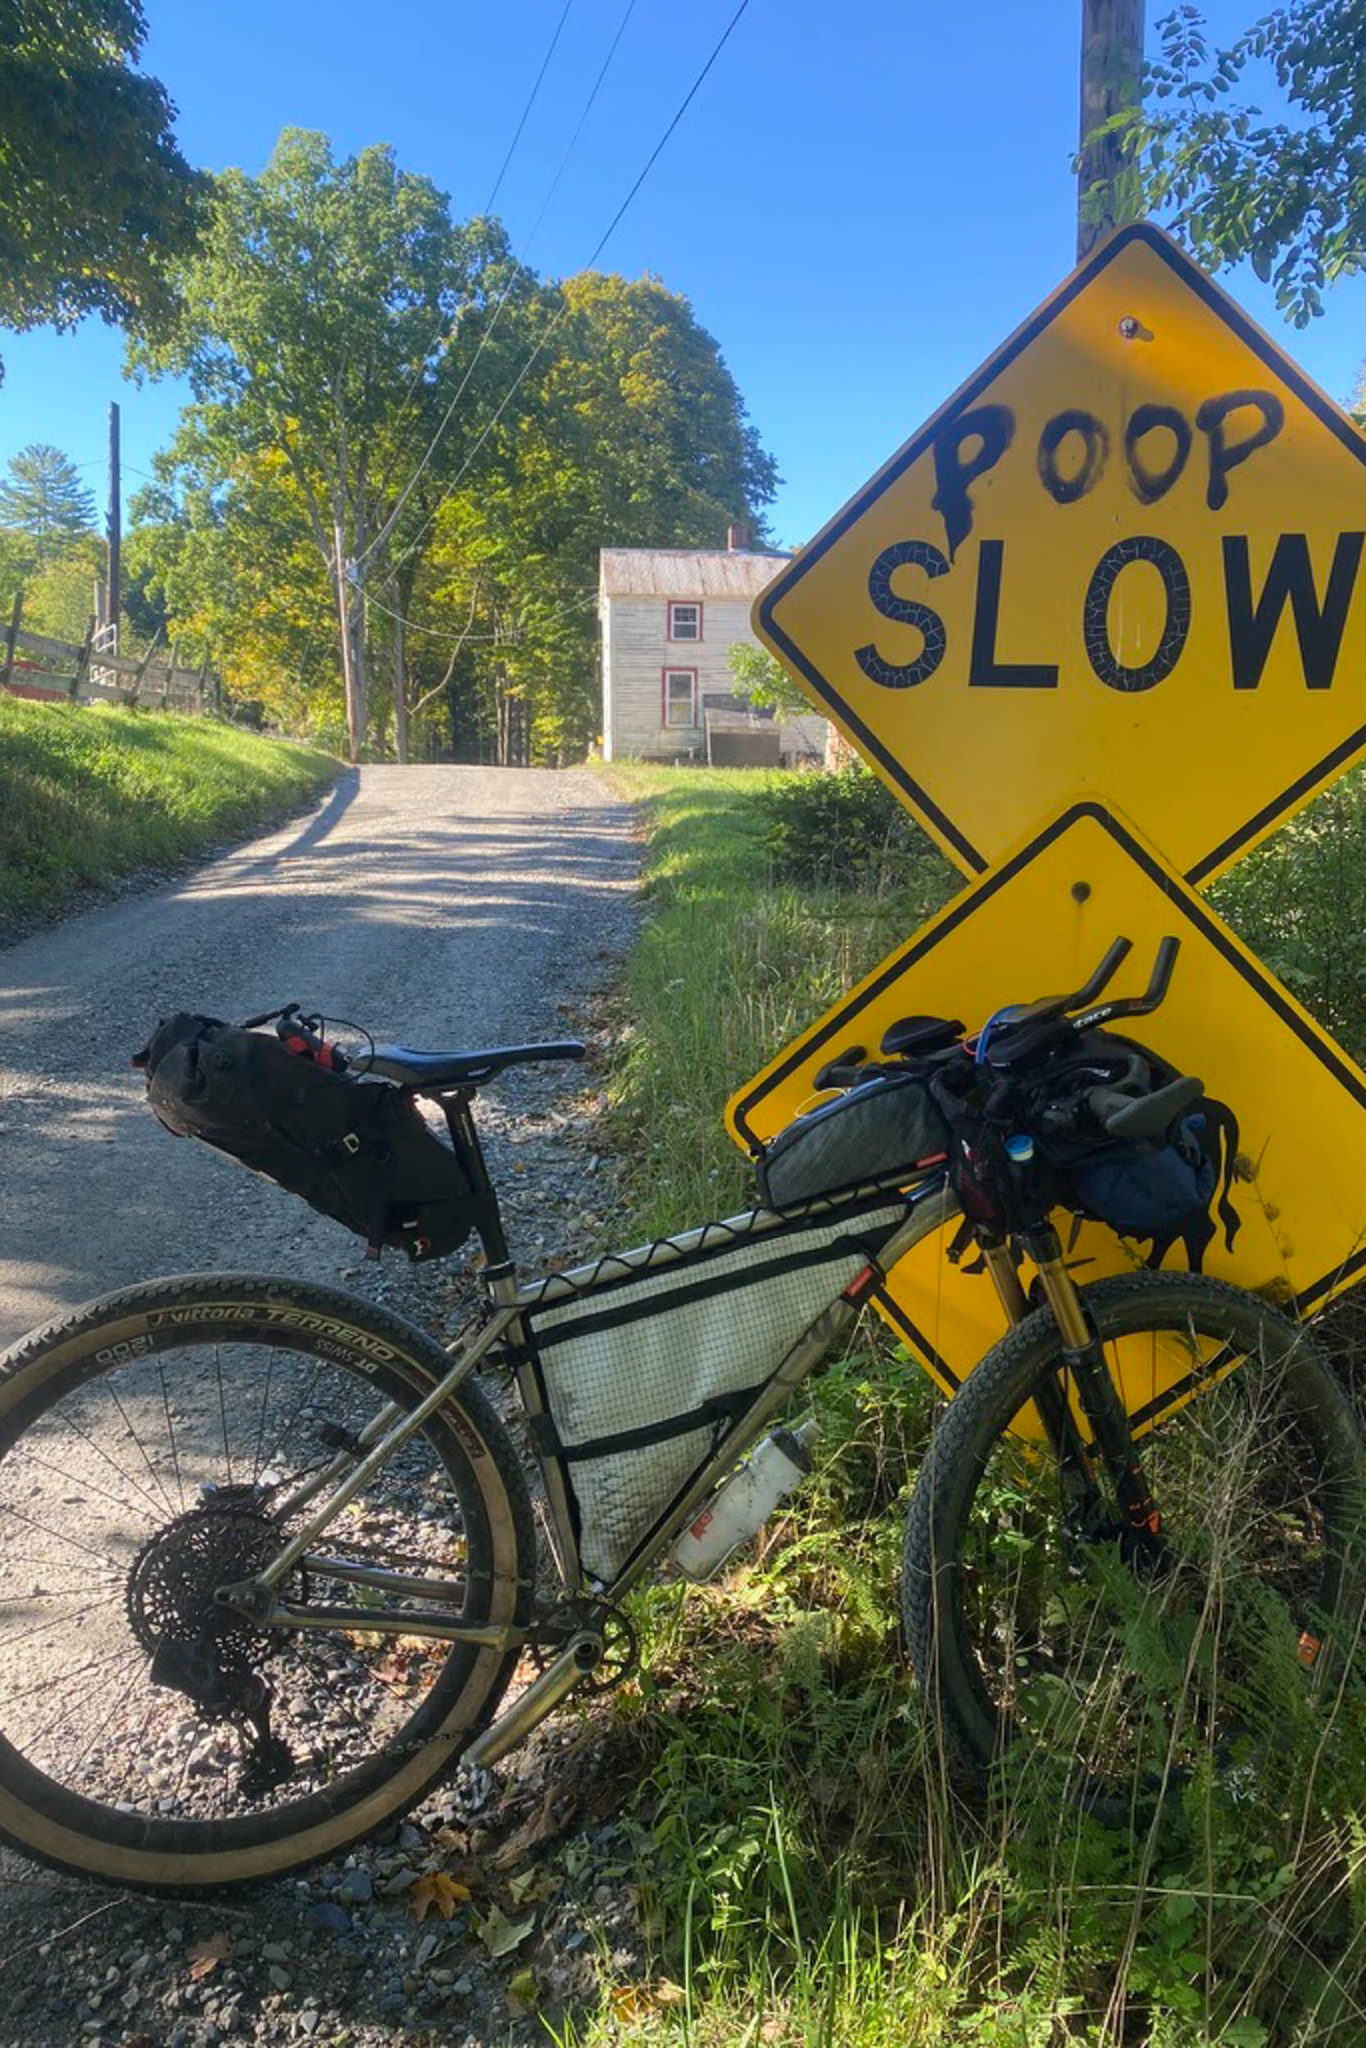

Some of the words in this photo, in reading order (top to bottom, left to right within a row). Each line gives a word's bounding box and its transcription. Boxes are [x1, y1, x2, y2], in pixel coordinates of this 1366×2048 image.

[932, 389, 1285, 564] POOP
[853, 532, 1366, 692] SLOW
[266, 1309, 395, 1361] TERRENO
